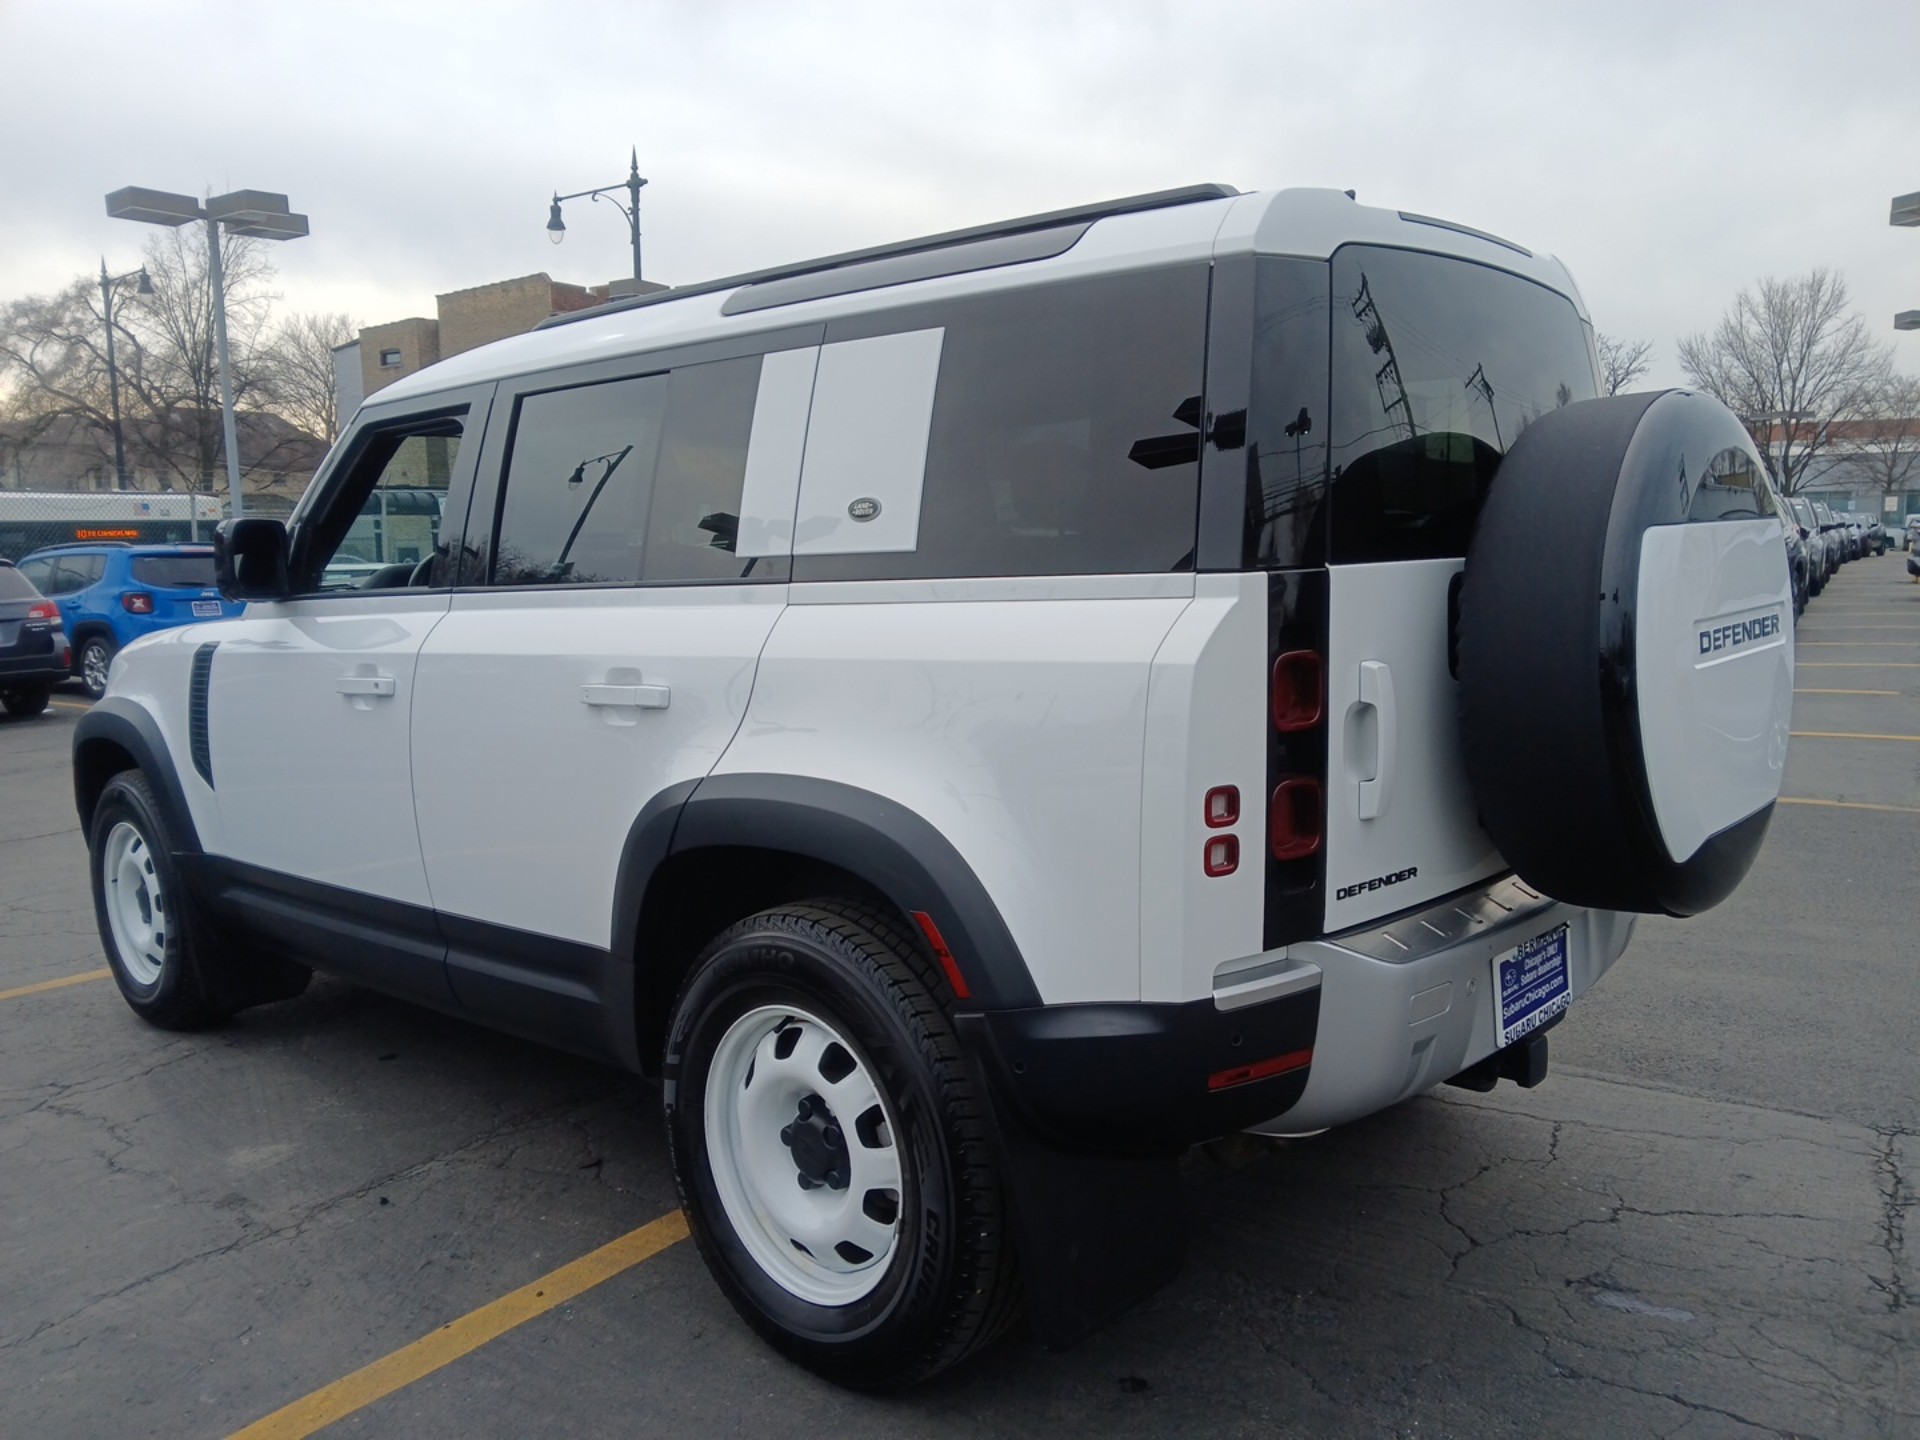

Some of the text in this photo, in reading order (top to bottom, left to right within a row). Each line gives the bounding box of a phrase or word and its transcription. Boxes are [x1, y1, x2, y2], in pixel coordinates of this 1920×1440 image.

[1699, 613, 1780, 655] DEFENDER
[1336, 866, 1418, 901] DEFENDER
[1503, 991, 1572, 1045] SUBARU CHICAGO
